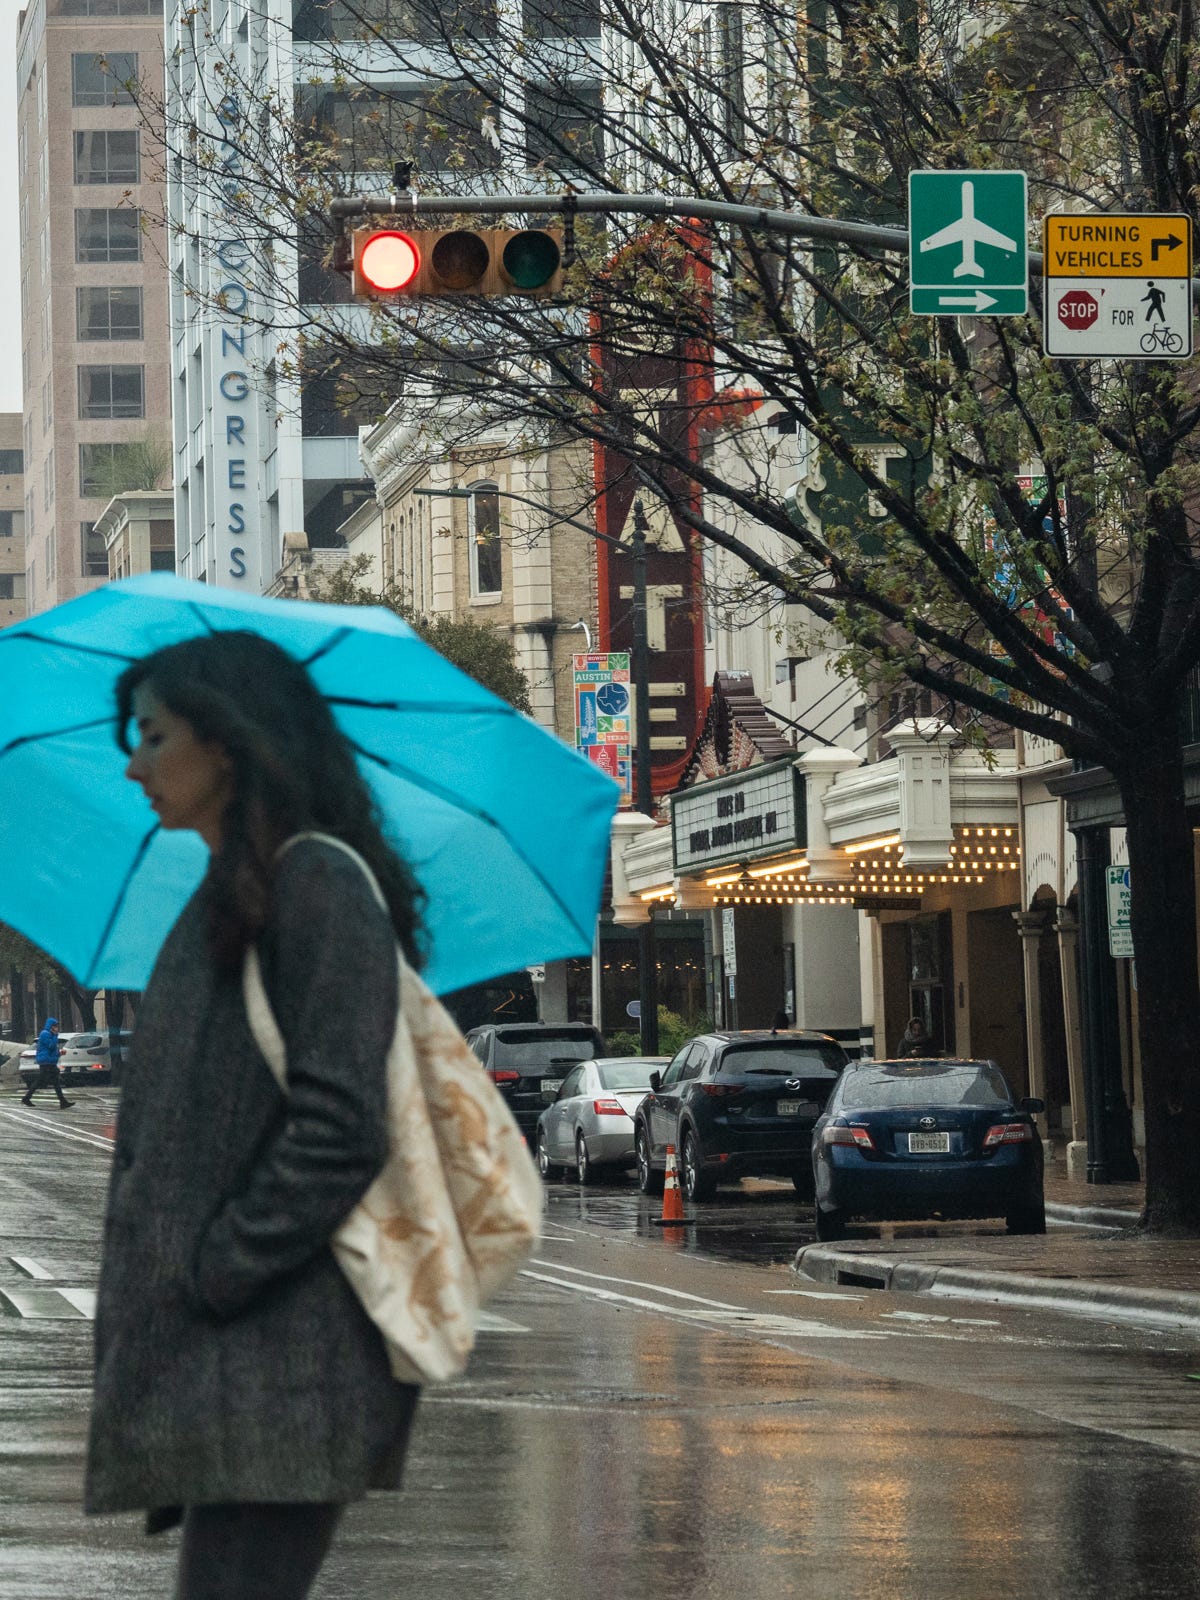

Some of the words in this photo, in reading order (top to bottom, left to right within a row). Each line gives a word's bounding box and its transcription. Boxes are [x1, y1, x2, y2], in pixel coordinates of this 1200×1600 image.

[1057, 225, 1140, 242] TURNING
[1055, 251, 1143, 267] VEHICLES
[1059, 302, 1097, 318] STOP
[1112, 309, 1134, 326] FOR
[218, 239, 249, 579] CONGRESS
[575, 672, 611, 682] AUSTIN
